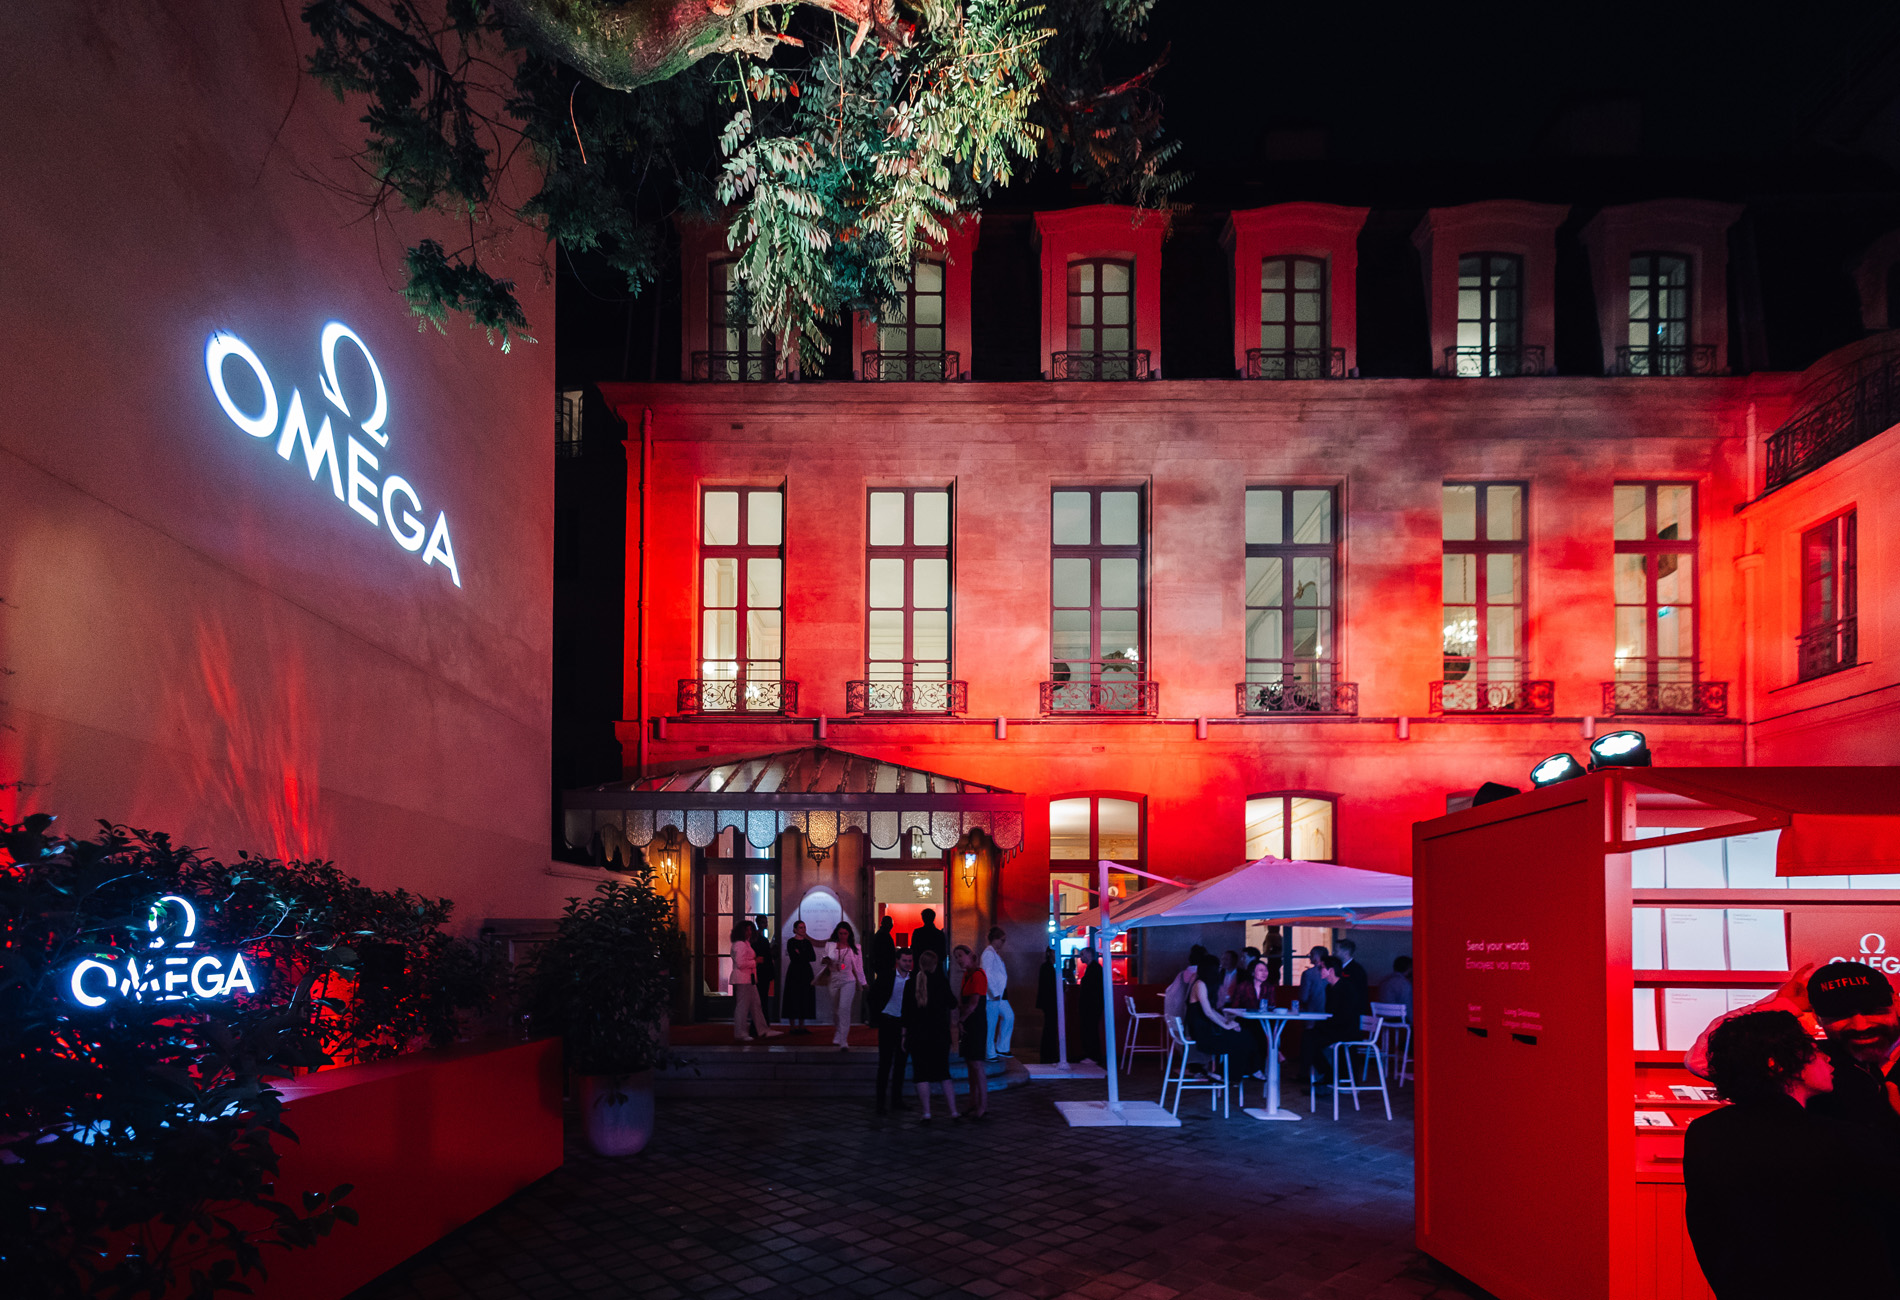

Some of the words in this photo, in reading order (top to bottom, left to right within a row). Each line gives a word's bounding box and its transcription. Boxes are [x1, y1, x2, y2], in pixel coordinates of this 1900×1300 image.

[204, 329, 462, 588] OMEGA
[1466, 939, 1485, 951] Send
[1486, 942, 1503, 954] your
[1504, 938, 1530, 951] words
[1465, 957, 1495, 972] Envoyez
[1496, 961, 1509, 970] vos
[1510, 960, 1531, 971] mots
[1820, 976, 1870, 993] NETFLIX
